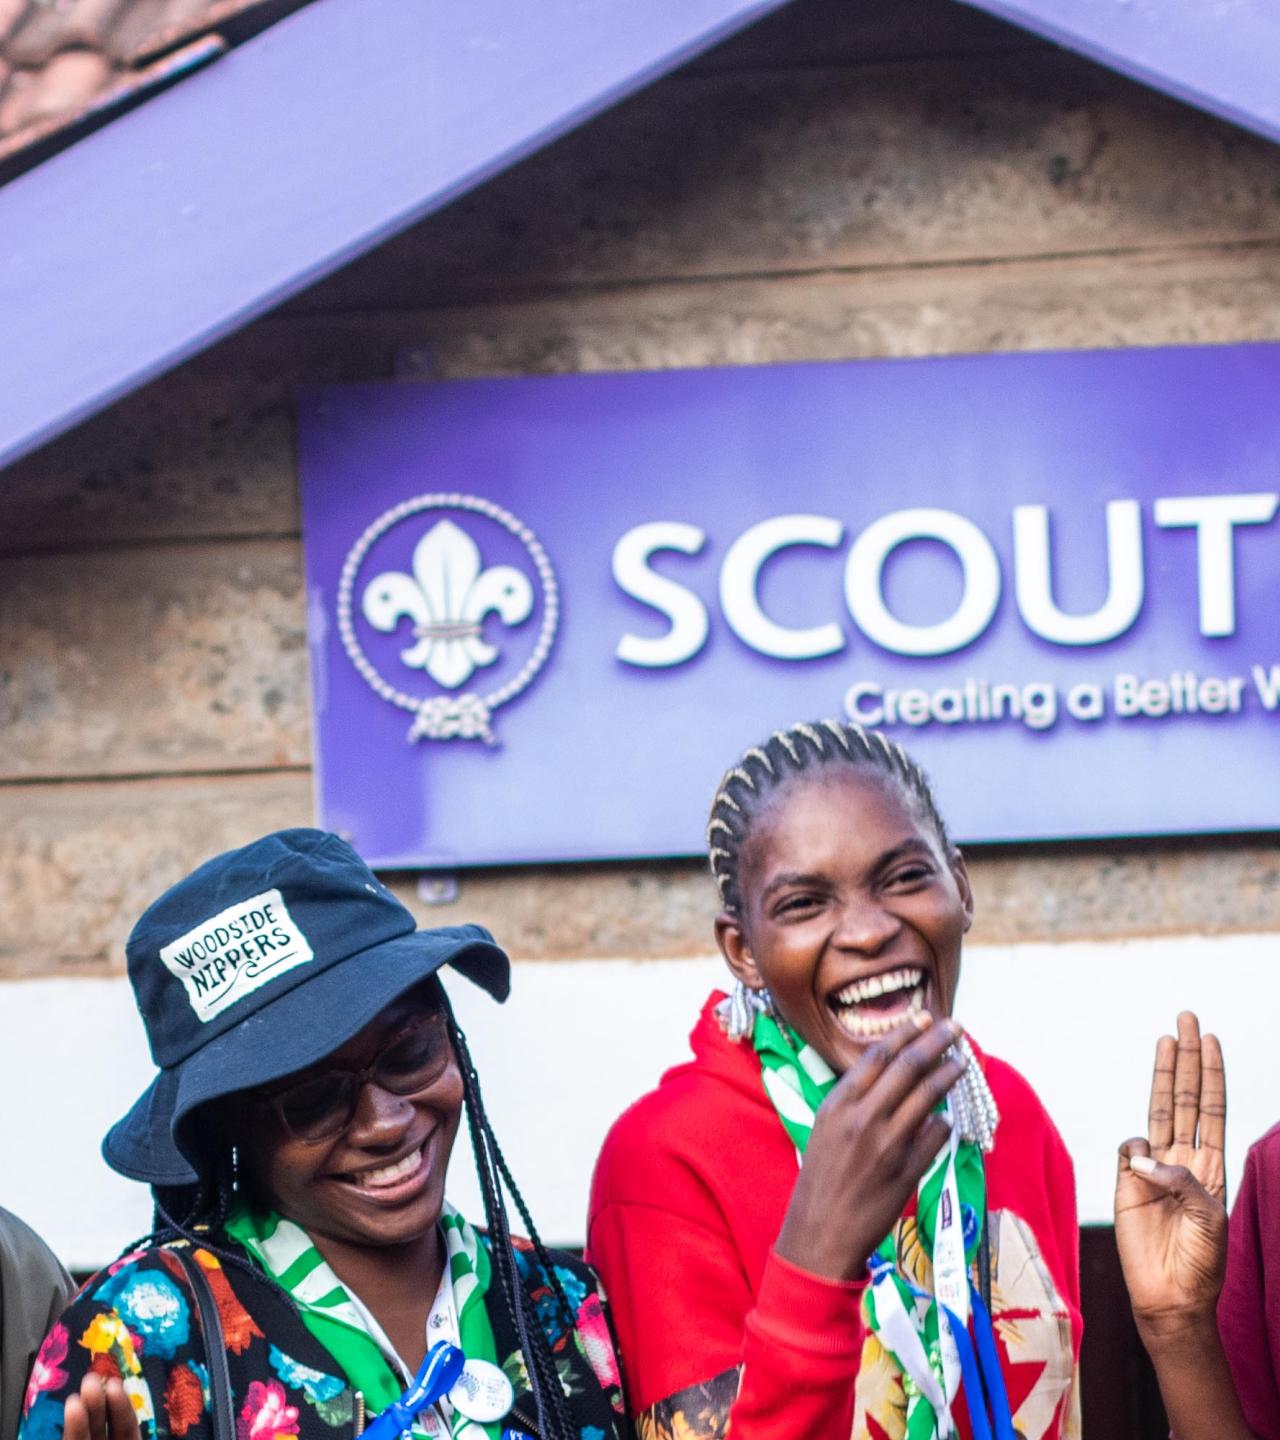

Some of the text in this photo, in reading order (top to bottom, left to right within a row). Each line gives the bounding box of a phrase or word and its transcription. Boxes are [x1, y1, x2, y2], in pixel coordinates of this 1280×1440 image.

[845, 679, 1056, 730] Creating
[1066, 683, 1104, 720] a
[1114, 673, 1245, 716] Better
[173, 904, 278, 971] WOODSIDE
[191, 928, 292, 998] NIPPERS
